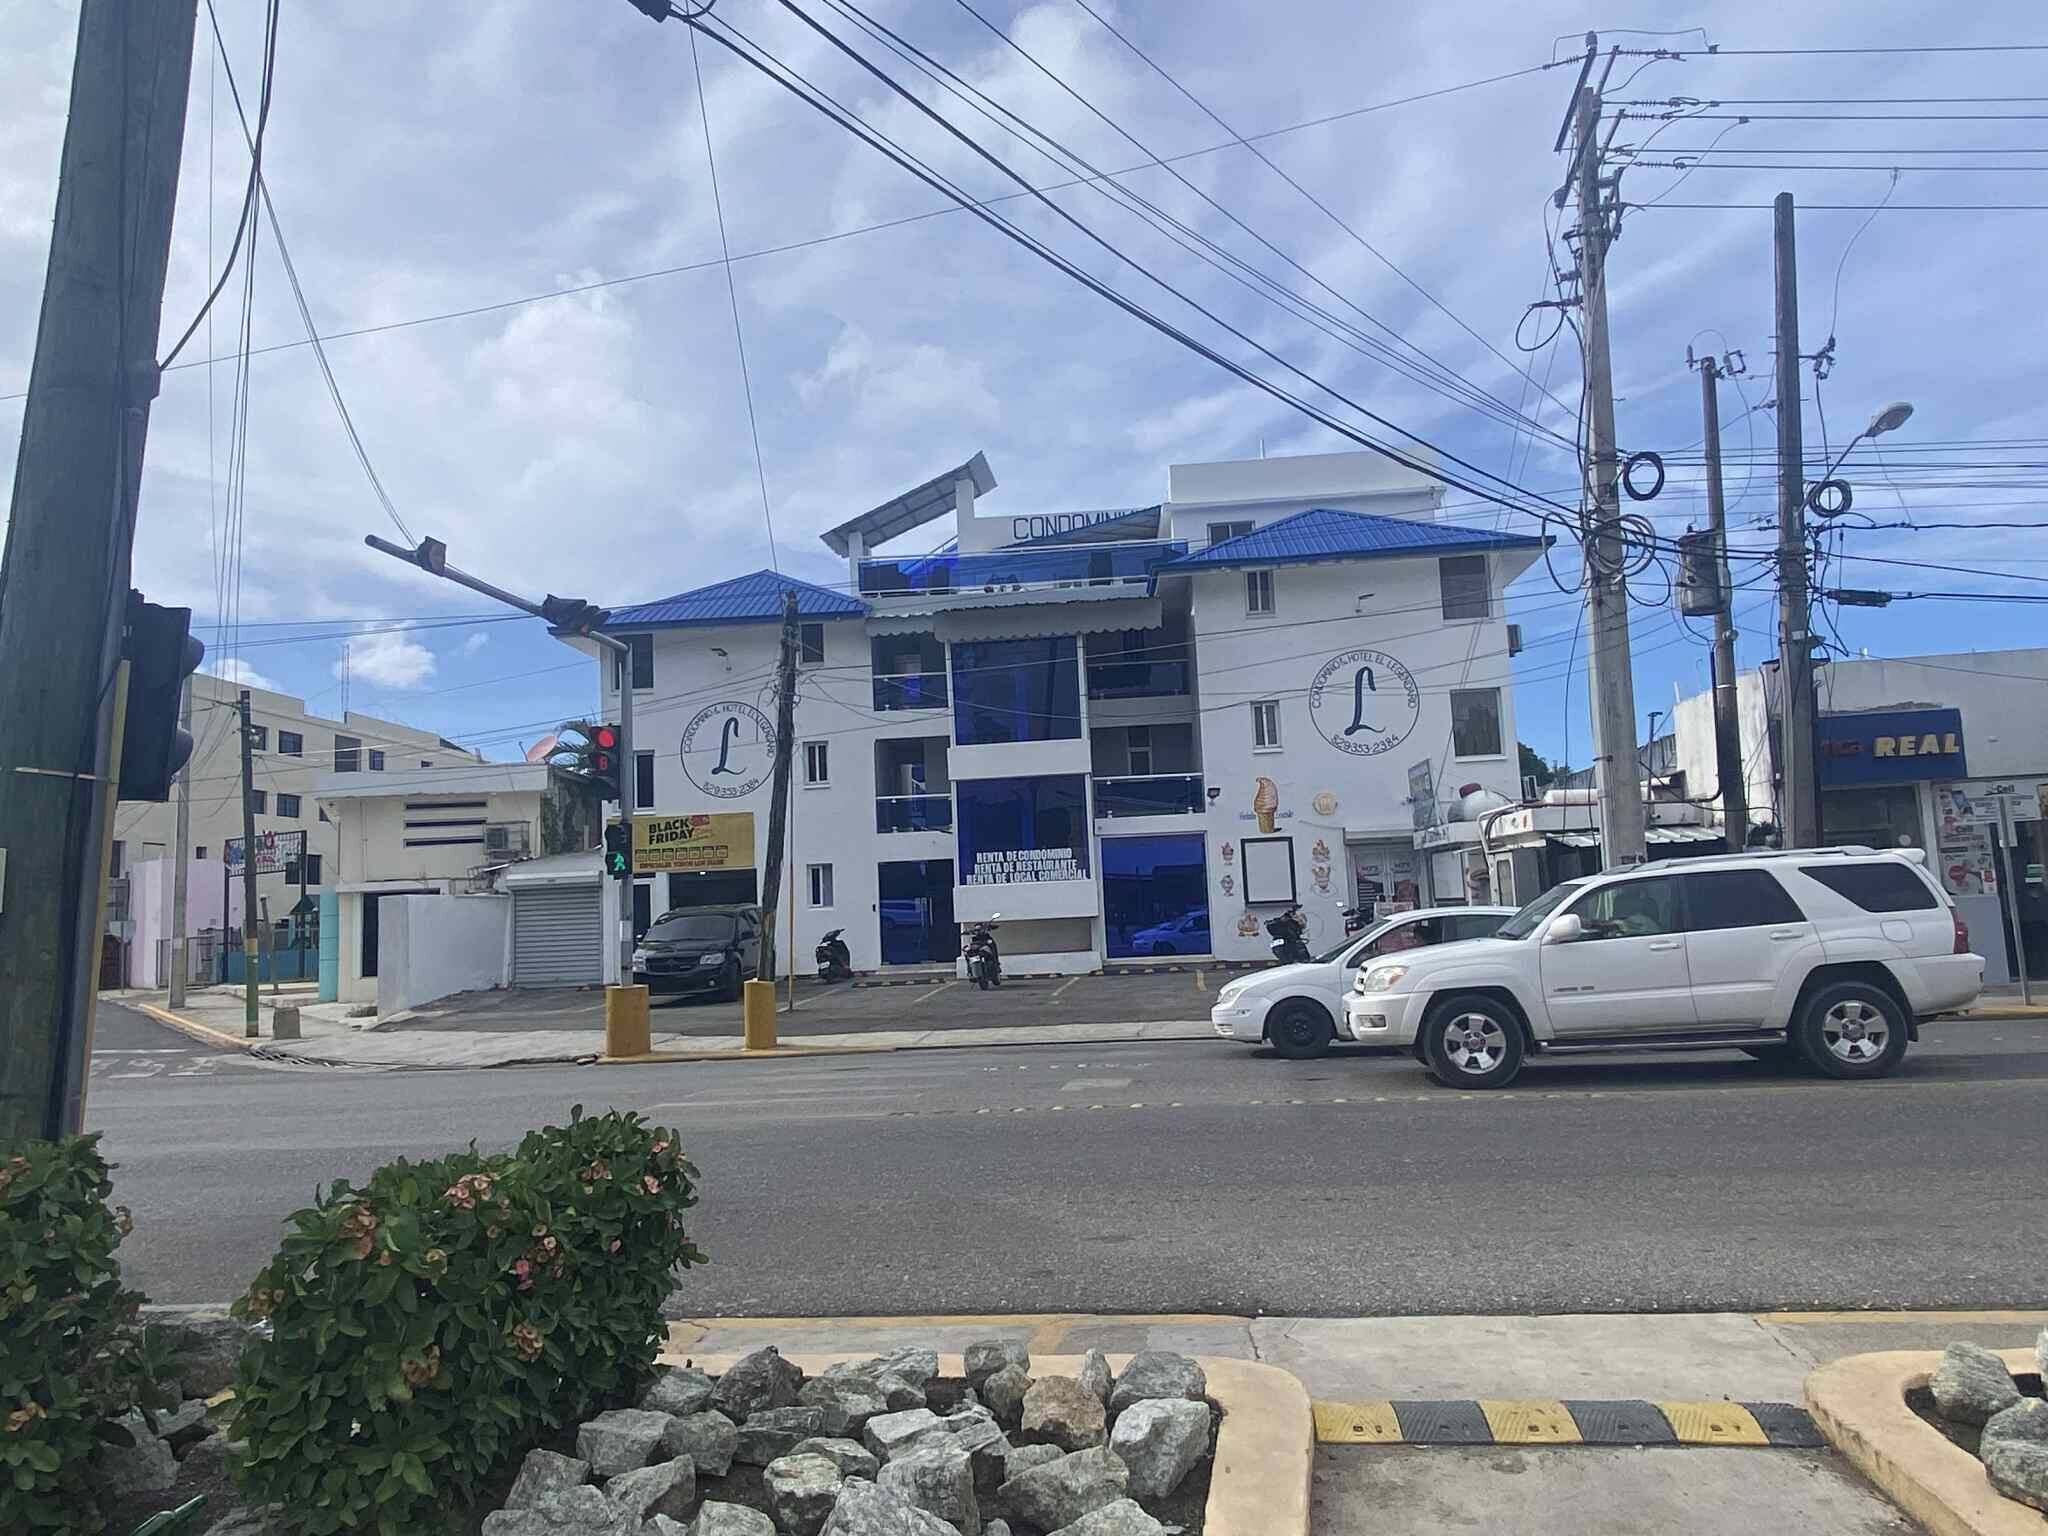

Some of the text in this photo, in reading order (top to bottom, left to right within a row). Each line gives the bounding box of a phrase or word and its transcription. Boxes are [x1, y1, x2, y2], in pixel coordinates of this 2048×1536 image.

[1014, 511, 1127, 539] CONDOM
[1348, 652, 1373, 664] HOTEL
[1375, 654, 1385, 666] EL
[1344, 666, 1387, 736] L
[711, 716, 747, 775] L
[1873, 732, 1961, 757] REAL
[648, 818, 690, 834] BLACK
[649, 827, 695, 845] FRIDAY
[976, 847, 1072, 864] RENTA DE CONDOMINIO
[974, 859, 1078, 874] RENTA DE RESTAURANTE
[966, 868, 1088, 885] RENTA DE LOCAL COMERCIAL
